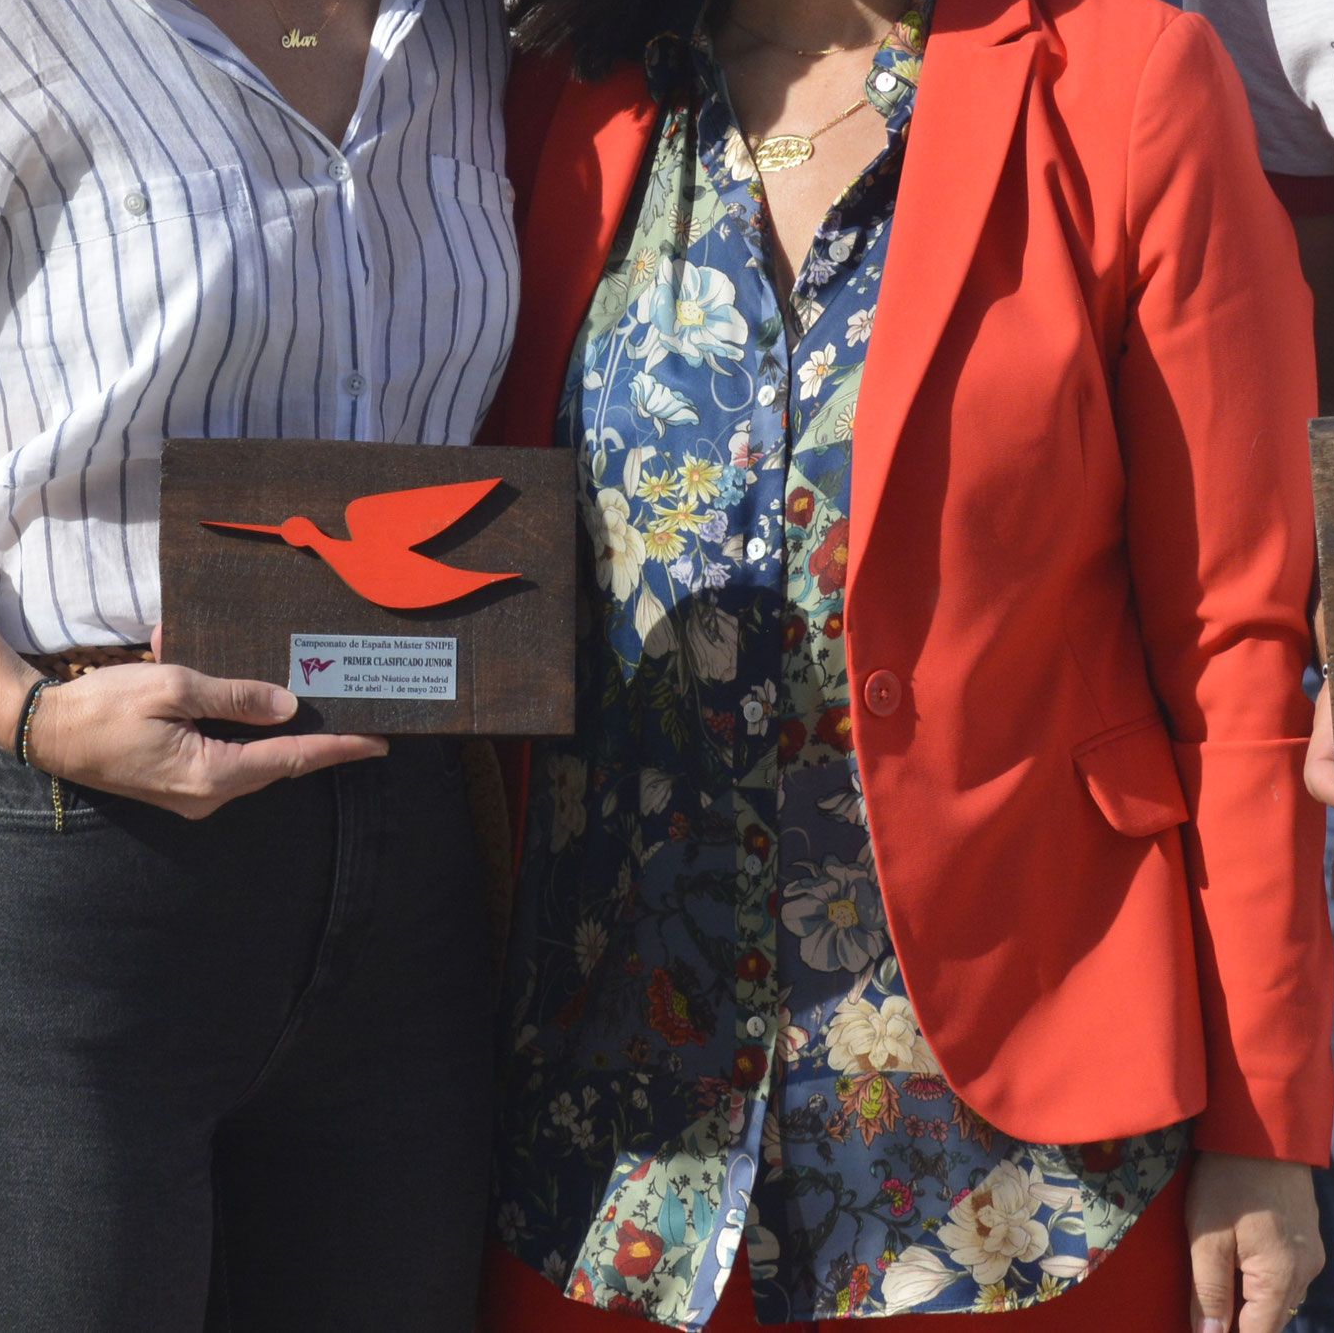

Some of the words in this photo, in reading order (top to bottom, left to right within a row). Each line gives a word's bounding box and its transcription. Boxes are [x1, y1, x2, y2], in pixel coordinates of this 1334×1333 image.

[294, 638, 347, 649] Campeonato
[348, 639, 360, 648] de
[361, 639, 392, 650] España
[393, 640, 422, 650] Máster
[425, 641, 454, 650] SNIPE
[343, 656, 372, 666] PRIMER
[373, 656, 424, 667] CLASIFICADO
[424, 657, 453, 668] JUNIOR
[344, 674, 360, 682] Real
[362, 674, 380, 682] Club
[381, 674, 410, 683] Náutico
[411, 675, 421, 683] de
[422, 676, 449, 684] Madrid
[365, 685, 382, 693] abril
[397, 685, 406, 693] de
[407, 687, 427, 695] mayo
[428, 686, 447, 694] 2023
